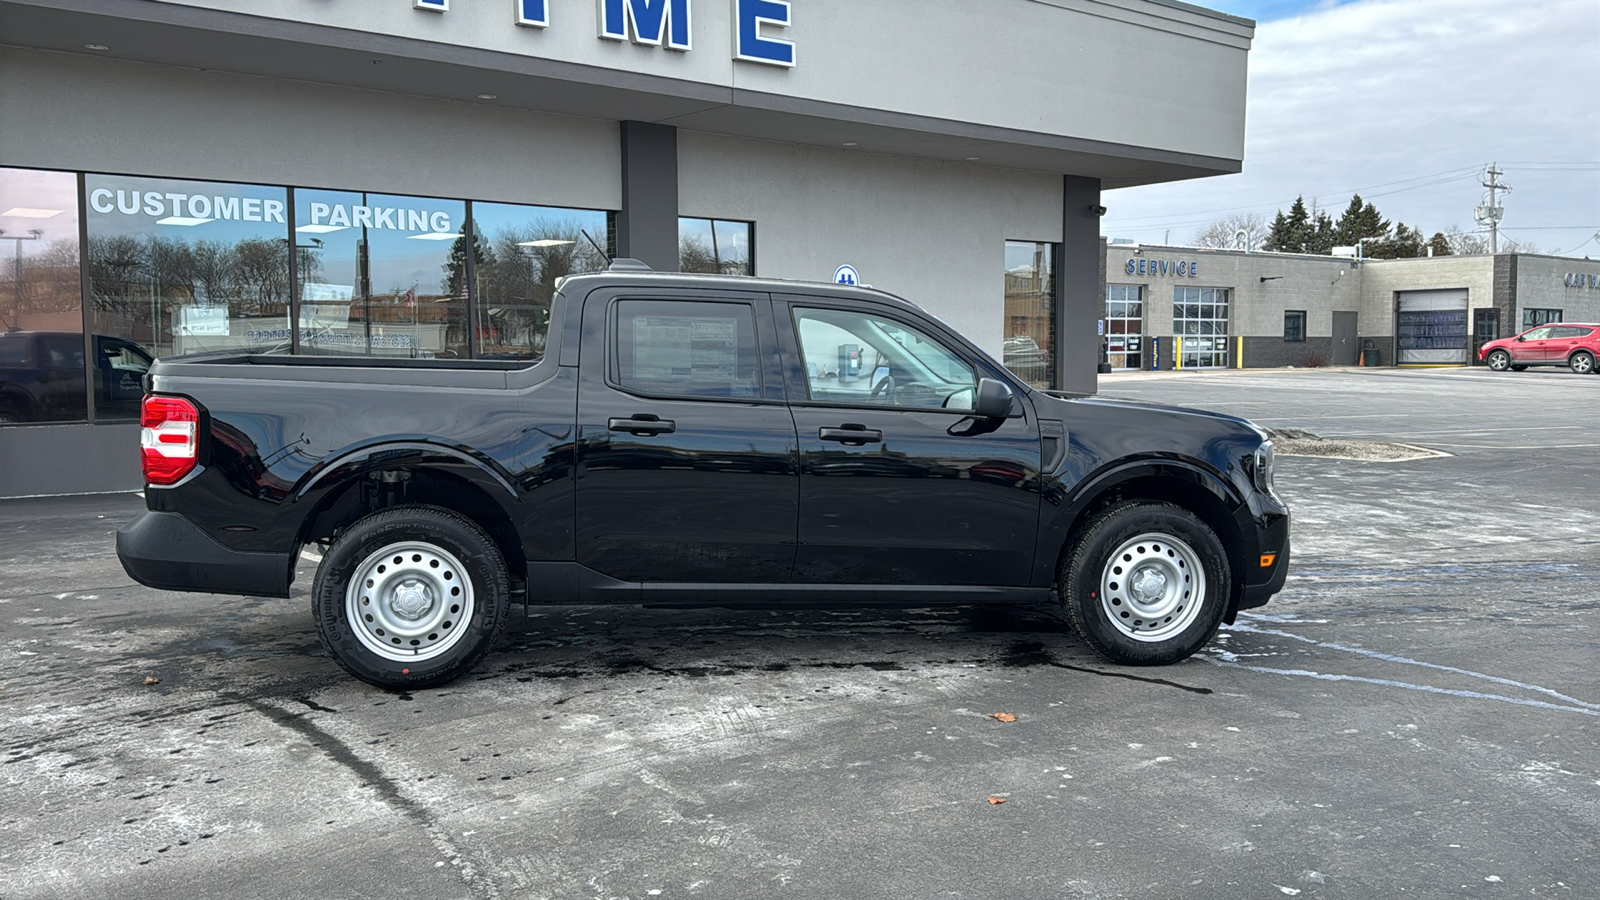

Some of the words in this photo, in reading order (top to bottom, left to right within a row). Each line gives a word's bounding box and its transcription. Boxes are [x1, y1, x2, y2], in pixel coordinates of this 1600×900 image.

[90, 188, 286, 223] CUSTOMER
[310, 202, 451, 233] PARKING
[1126, 258, 1198, 277] SERVICE
[1564, 272, 1586, 288] CAR
[322, 585, 342, 642] Continental
